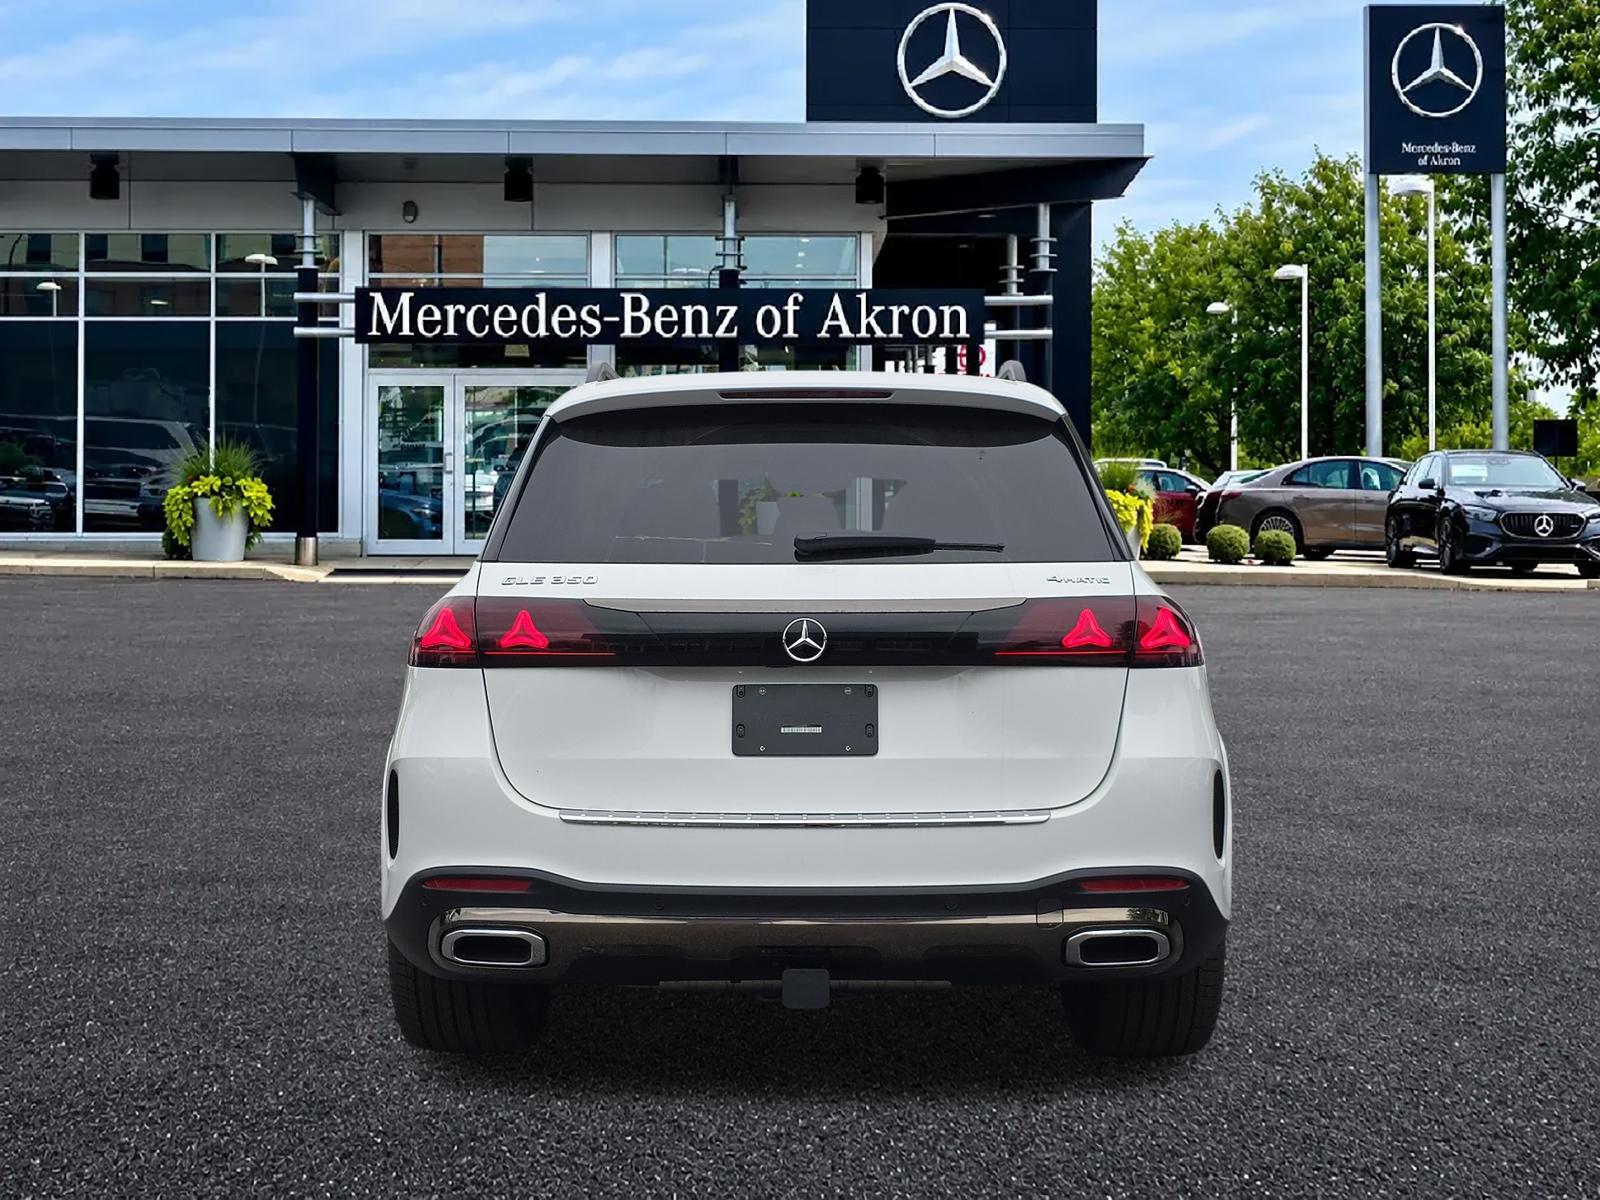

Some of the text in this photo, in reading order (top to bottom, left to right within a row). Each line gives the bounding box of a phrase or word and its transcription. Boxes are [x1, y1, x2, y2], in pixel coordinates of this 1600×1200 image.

[1401, 142, 1476, 153] Mercedes-Benz
[1417, 155, 1461, 166] of Akron
[367, 292, 971, 338] Mercedes-Benz of Akron
[501, 576, 598, 586] GLE 350
